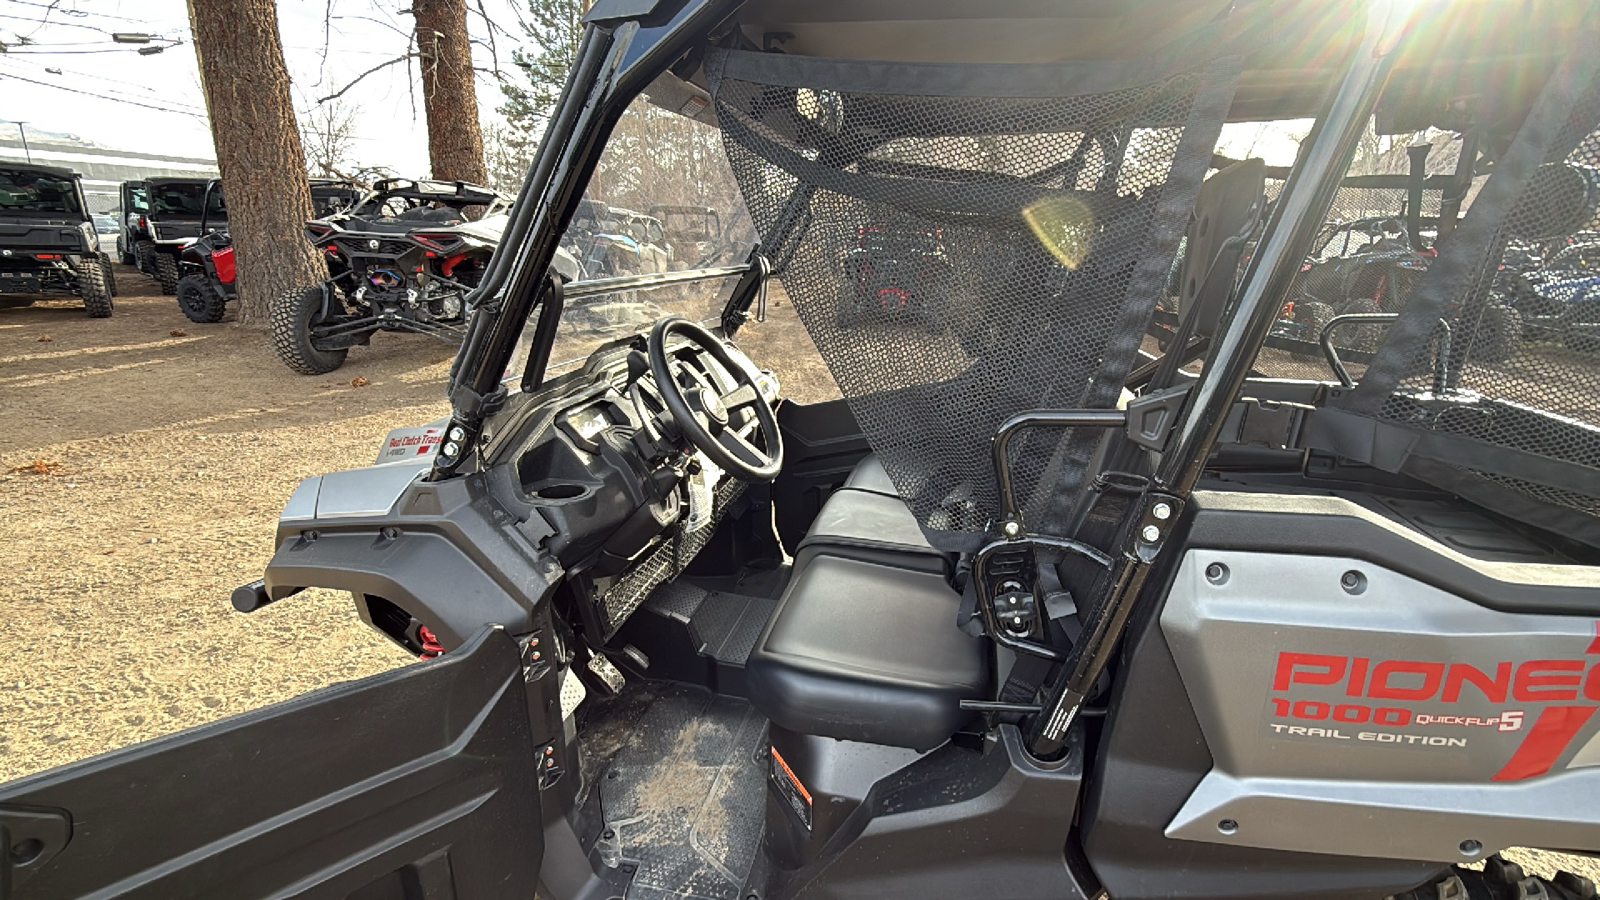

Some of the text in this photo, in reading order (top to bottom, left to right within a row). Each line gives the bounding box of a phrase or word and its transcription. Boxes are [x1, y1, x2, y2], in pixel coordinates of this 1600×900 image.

[421, 434, 442, 444] Trans
[1273, 651, 1600, 703] PIONE
[1271, 698, 1412, 727] 1000
[1270, 724, 1467, 748] TRAIL EDITION
